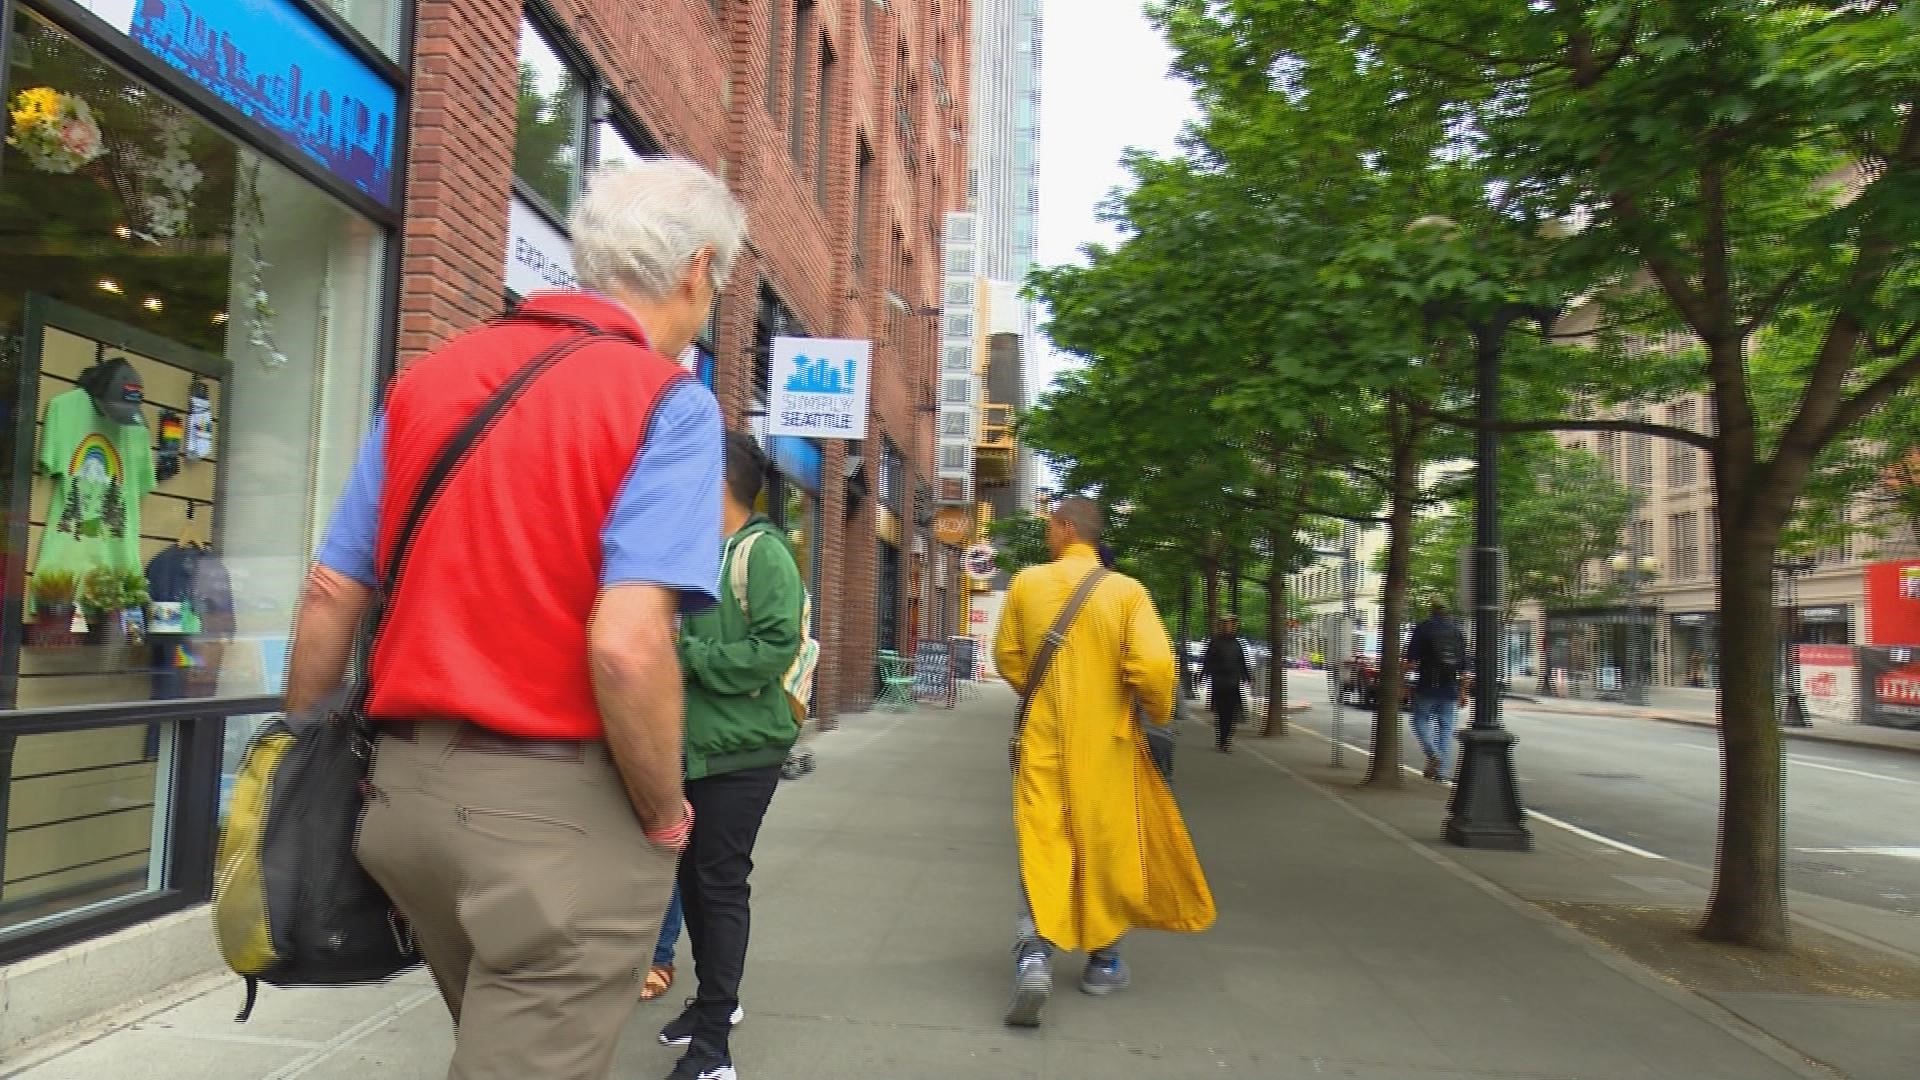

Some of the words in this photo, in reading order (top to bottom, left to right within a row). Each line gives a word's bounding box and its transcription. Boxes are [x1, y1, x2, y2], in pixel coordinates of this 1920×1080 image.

[781, 394, 854, 412] SIMPLY
[780, 411, 853, 429] SEATTLE
[935, 517, 967, 533] BOX
